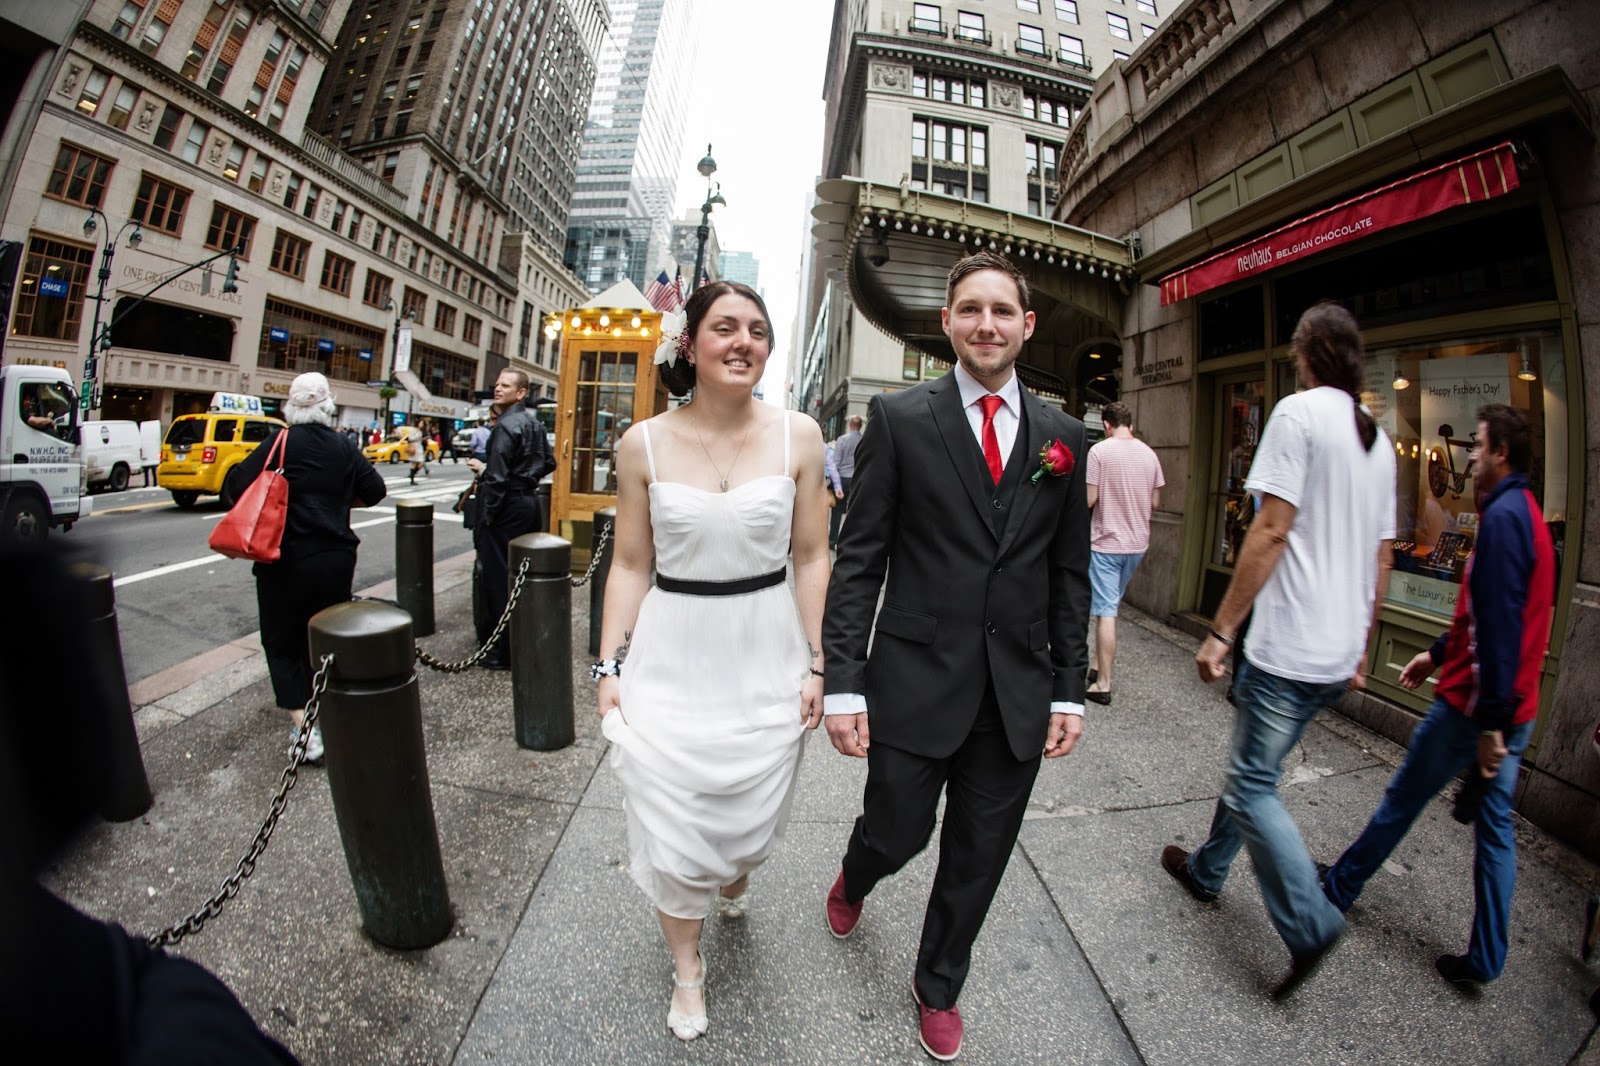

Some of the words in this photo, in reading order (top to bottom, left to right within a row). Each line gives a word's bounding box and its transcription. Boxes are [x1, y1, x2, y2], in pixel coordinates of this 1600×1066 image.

[1238, 246, 1272, 272] neuhaus
[1276, 239, 1313, 259] BELGIAN
[1314, 217, 1373, 245] CHOCOLATE
[124, 265, 143, 279] ONE
[41, 282, 61, 292] CHASE
[1429, 386, 1451, 398] Happy
[1453, 384, 1481, 394] Father's
[1483, 383, 1500, 396] Day!
[1402, 581, 1416, 595] The
[1418, 585, 1445, 604] Luxury
